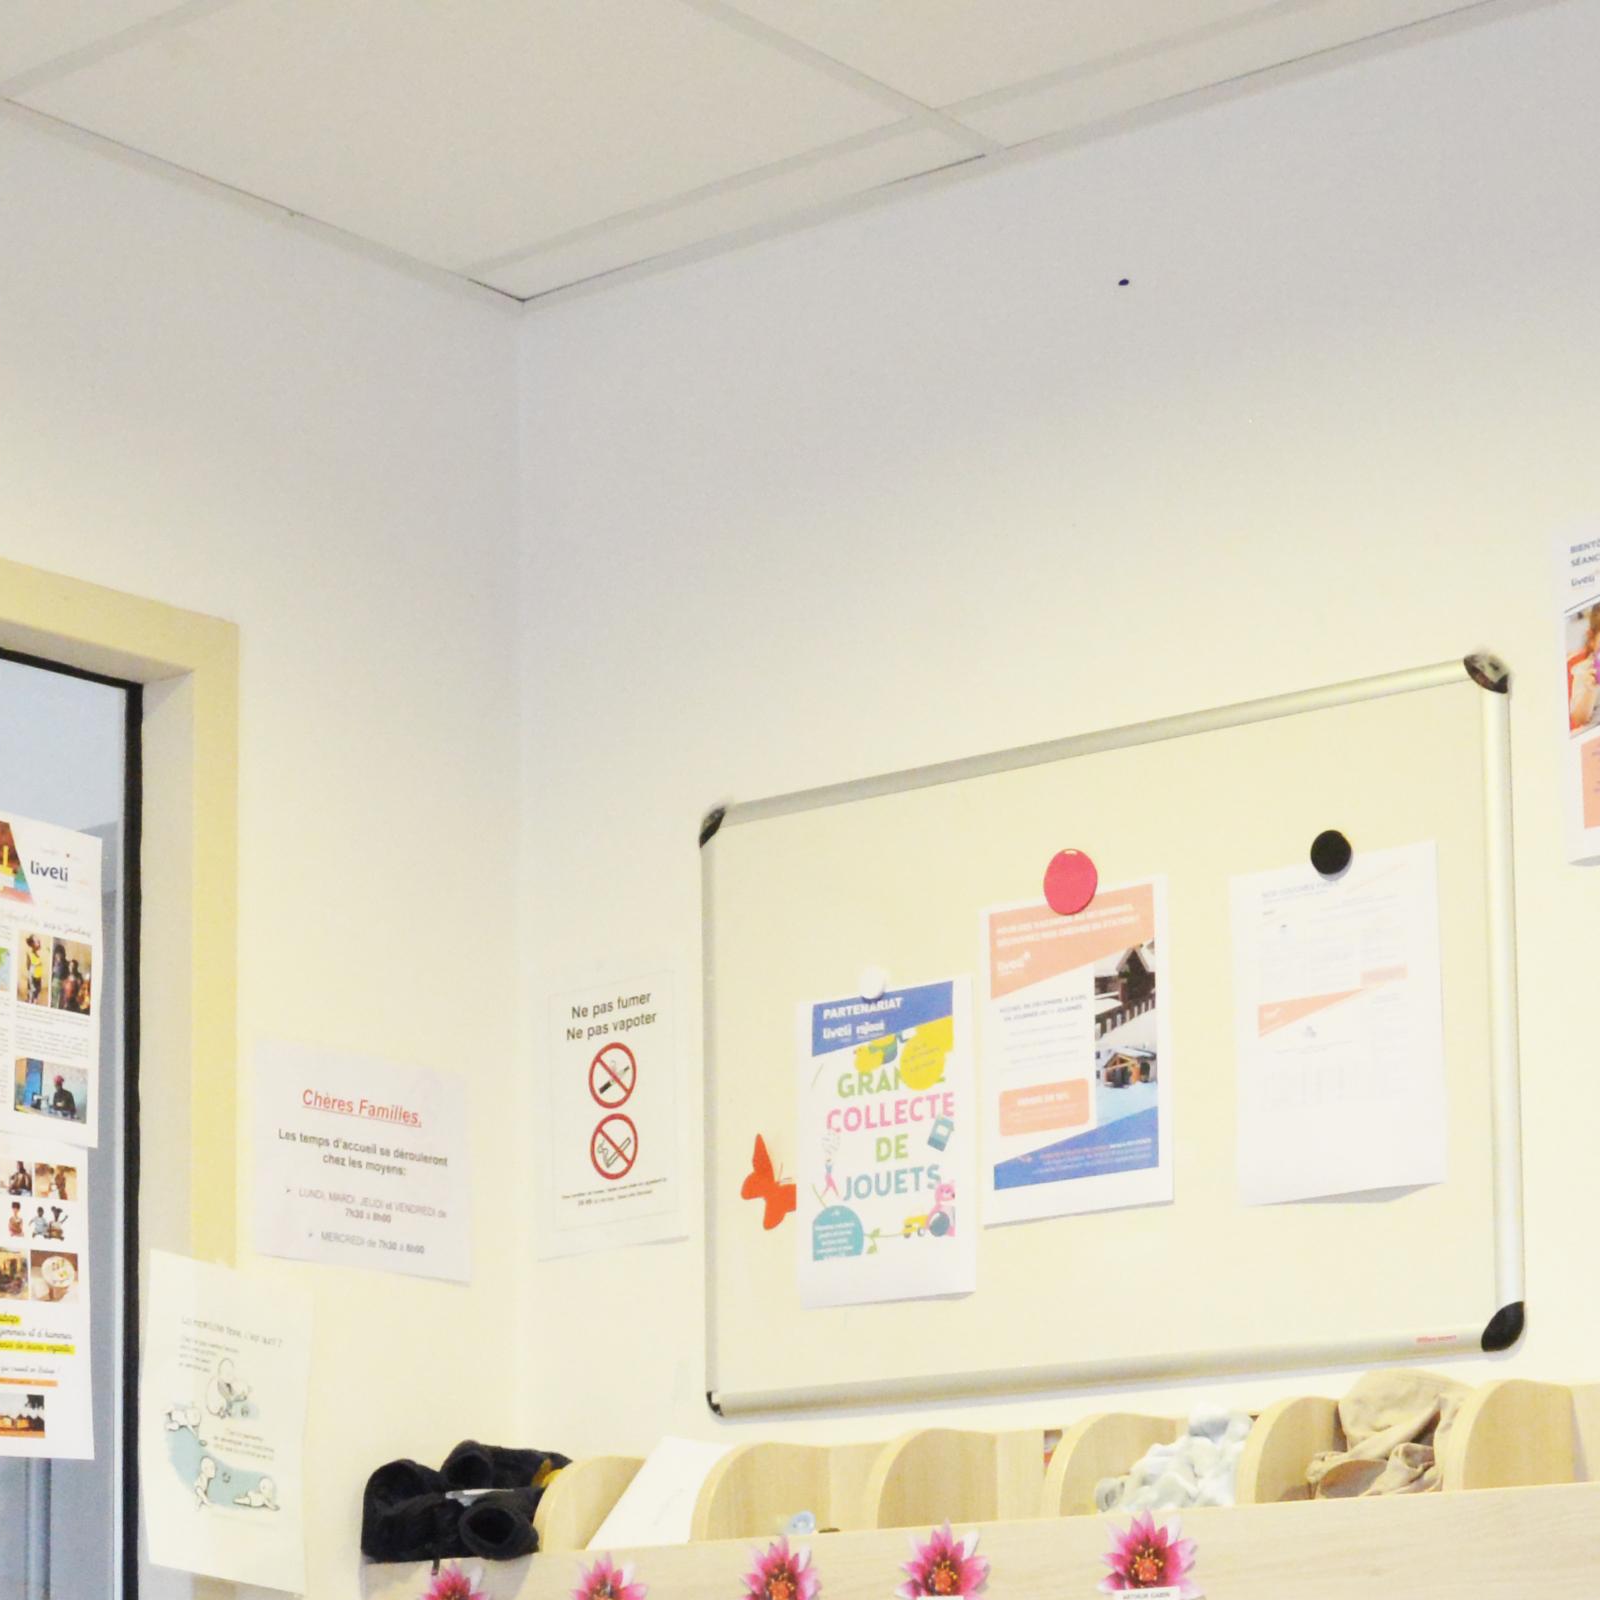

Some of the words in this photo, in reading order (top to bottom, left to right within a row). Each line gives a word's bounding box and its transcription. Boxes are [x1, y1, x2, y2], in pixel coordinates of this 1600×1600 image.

[571, 1006, 589, 1019] Ne
[592, 1001, 614, 1019] pas
[617, 992, 652, 1010] fumer
[823, 997, 904, 1020] PARTENARIAT
[566, 1026, 584, 1041] Ne
[587, 1022, 610, 1041] pas
[612, 1012, 657, 1033] vapoter
[302, 1088, 354, 1114] Chères
[826, 1092, 955, 1134] COLLECTE
[278, 1127, 297, 1142] Les
[300, 1132, 330, 1148] temps
[333, 1136, 377, 1154] d'accueil
[379, 1147, 391, 1158] se
[393, 1148, 449, 1167] dérouleront
[322, 1153, 346, 1167] chez
[348, 1156, 363, 1169] les
[875, 1133, 910, 1163] DE
[842, 1164, 942, 1201] JOUETS
